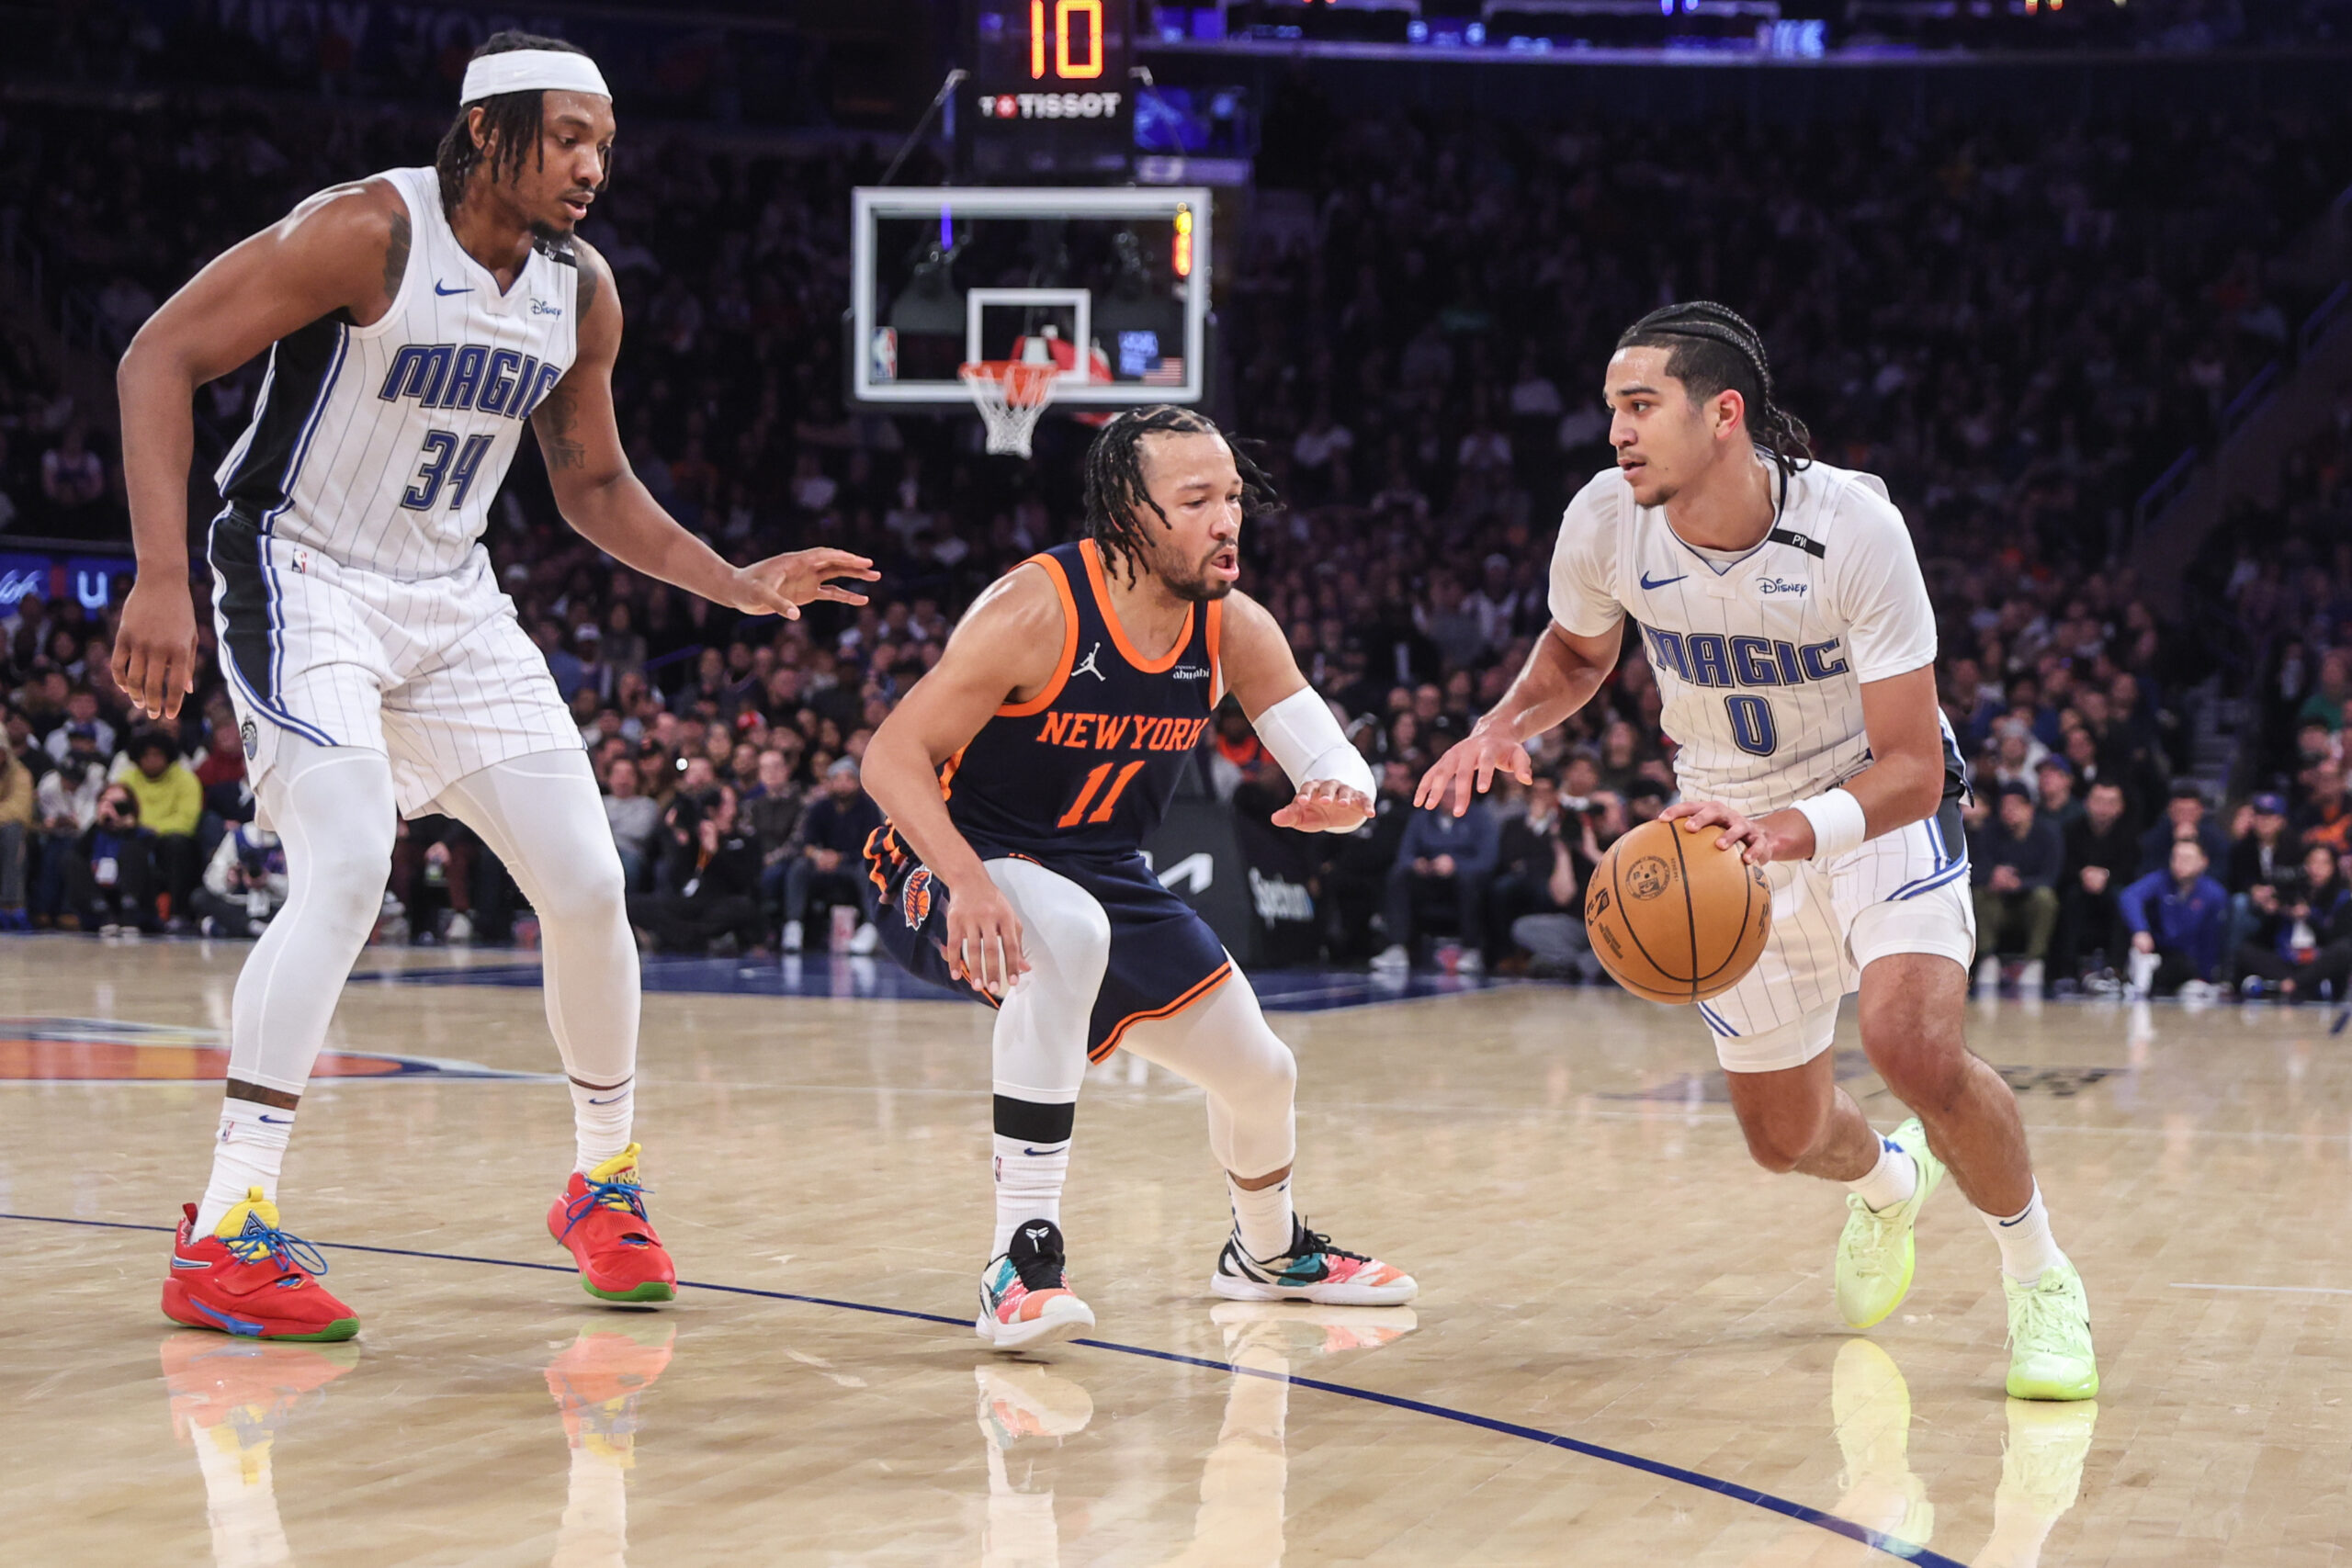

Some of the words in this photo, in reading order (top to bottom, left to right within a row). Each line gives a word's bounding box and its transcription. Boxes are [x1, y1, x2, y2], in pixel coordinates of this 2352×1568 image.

[1030, 0, 1103, 80] 10
[1017, 92, 1122, 119] TISSOT
[400, 429, 495, 512] 34
[1756, 577, 1808, 597] Disney
[1640, 621, 1849, 689] MAGIC
[1036, 711, 1131, 750] NEW
[1724, 694, 1778, 758] 0
[1057, 761, 1147, 829] 11
